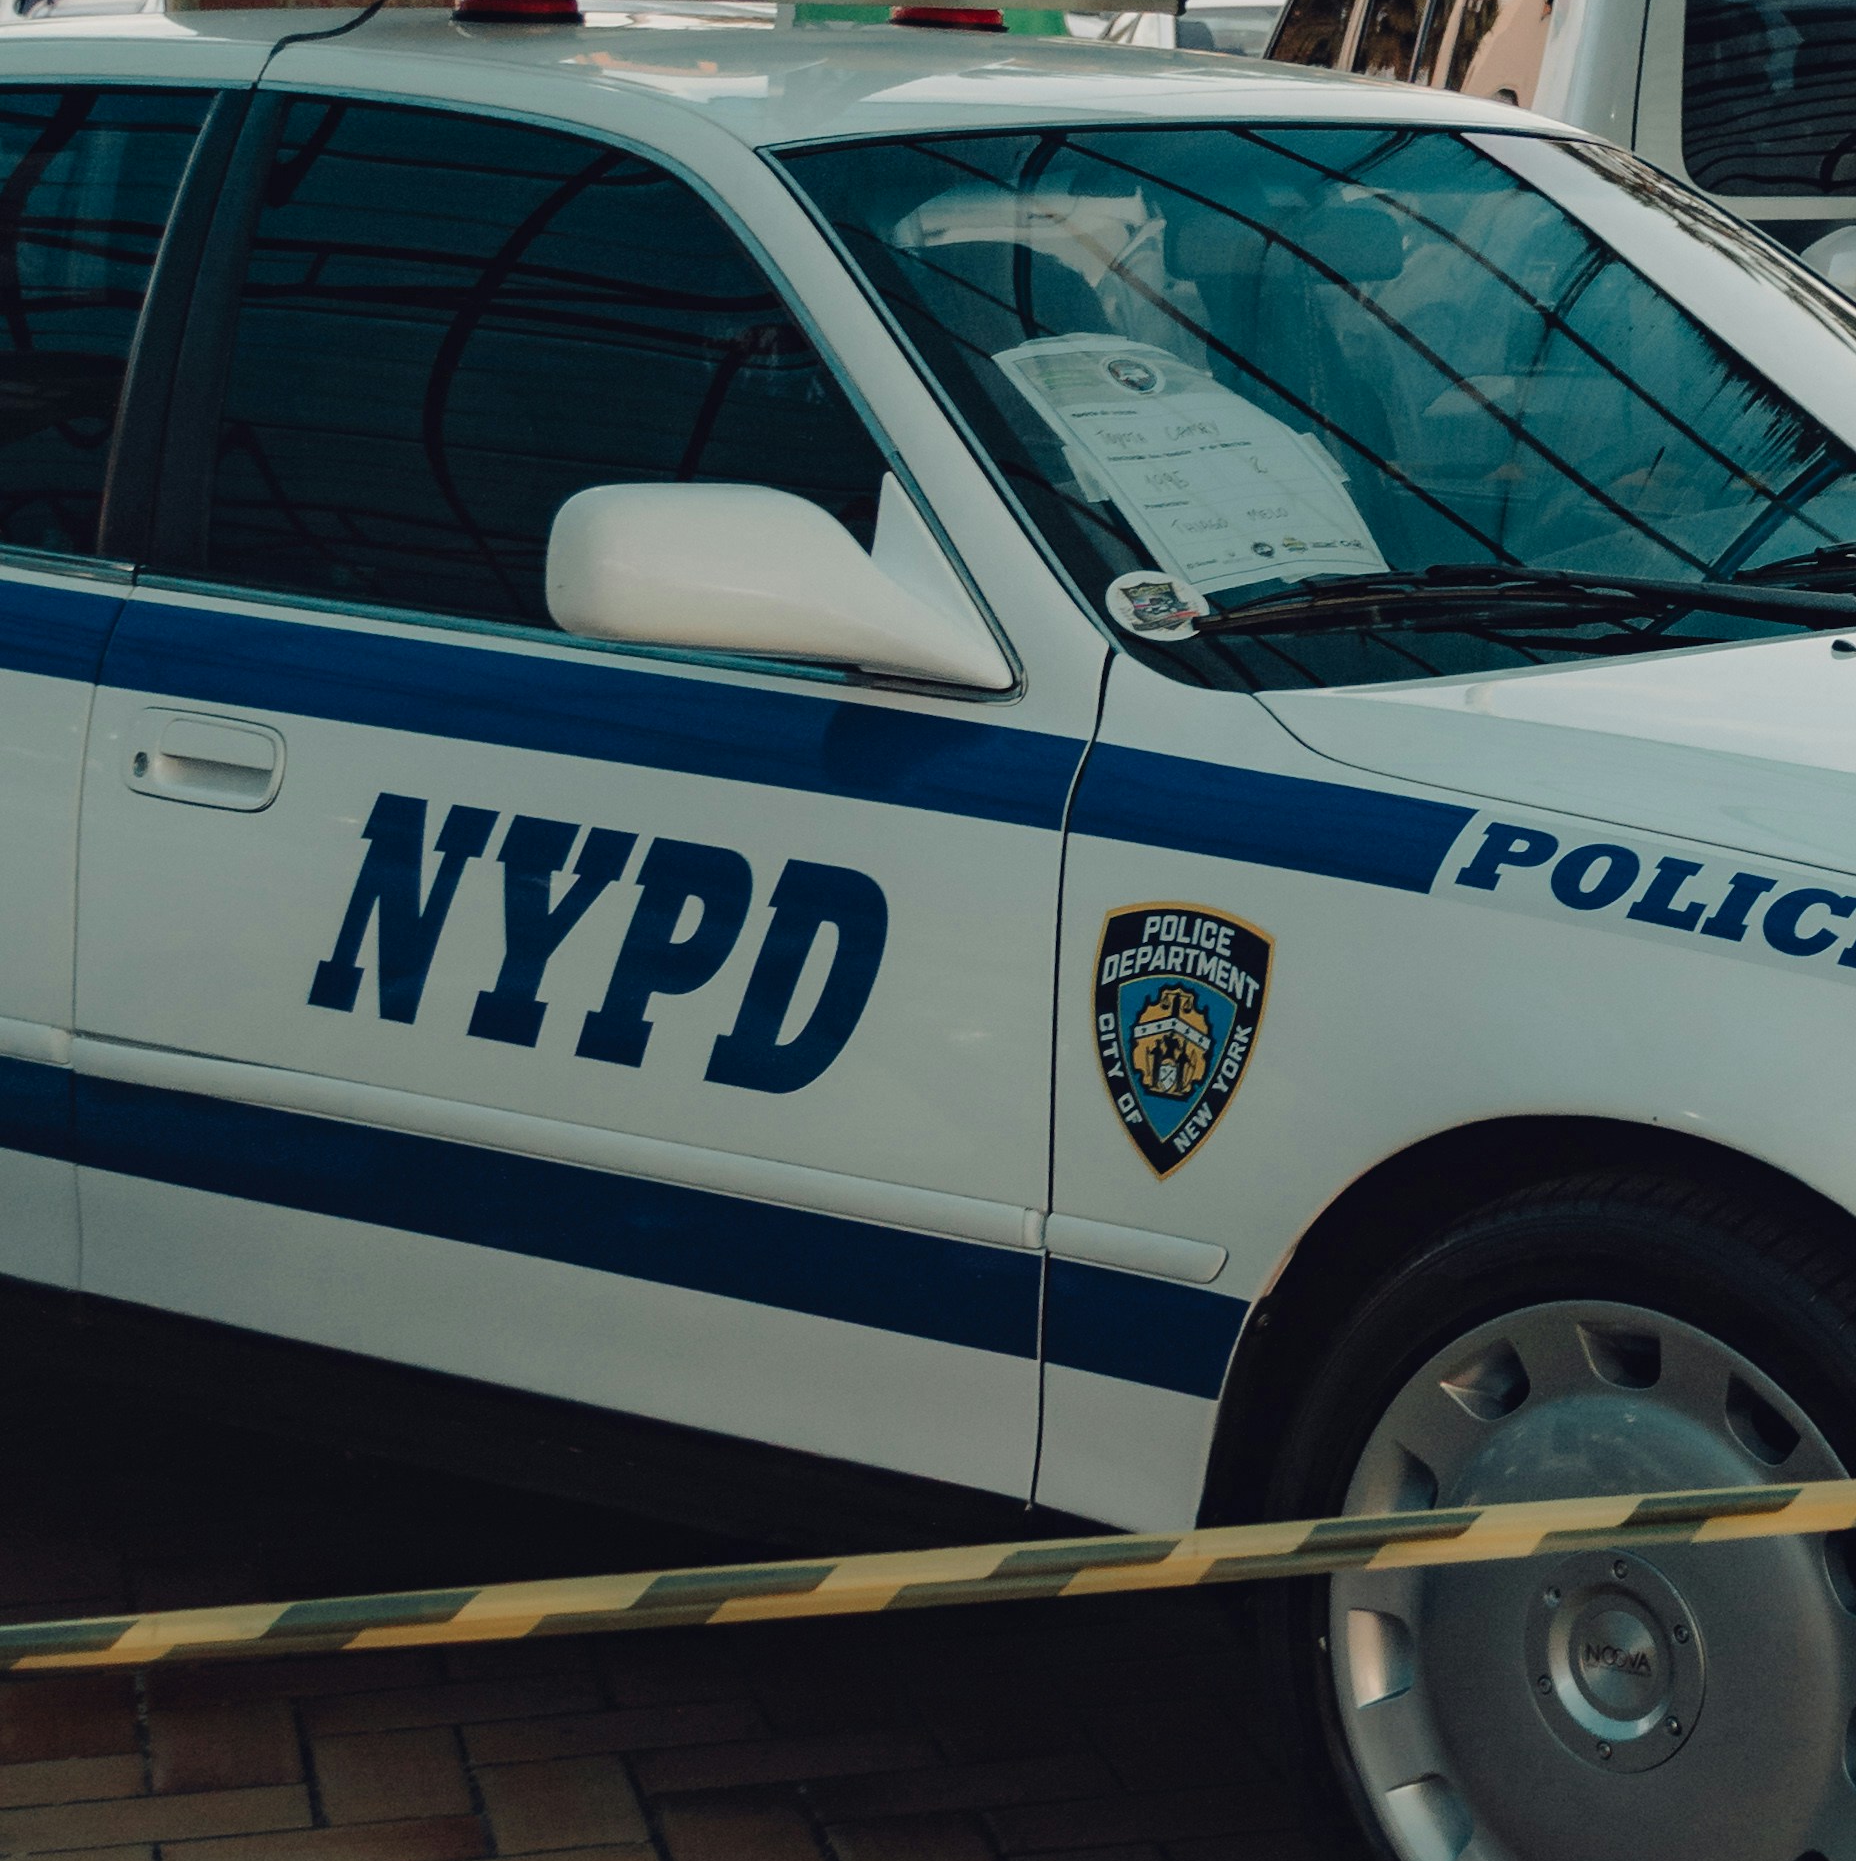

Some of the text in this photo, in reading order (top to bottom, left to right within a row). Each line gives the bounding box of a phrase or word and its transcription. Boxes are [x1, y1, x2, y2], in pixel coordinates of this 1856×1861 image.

[307, 792, 888, 1094] NYPD
[1101, 946, 1259, 1008] DEPARTMENT
[1143, 915, 1236, 956] POLICE
[1098, 1012, 1143, 1125] CITY OF
[1173, 1025, 1253, 1153] NEW YORK
[1585, 1644, 1652, 1672] NOOVA
